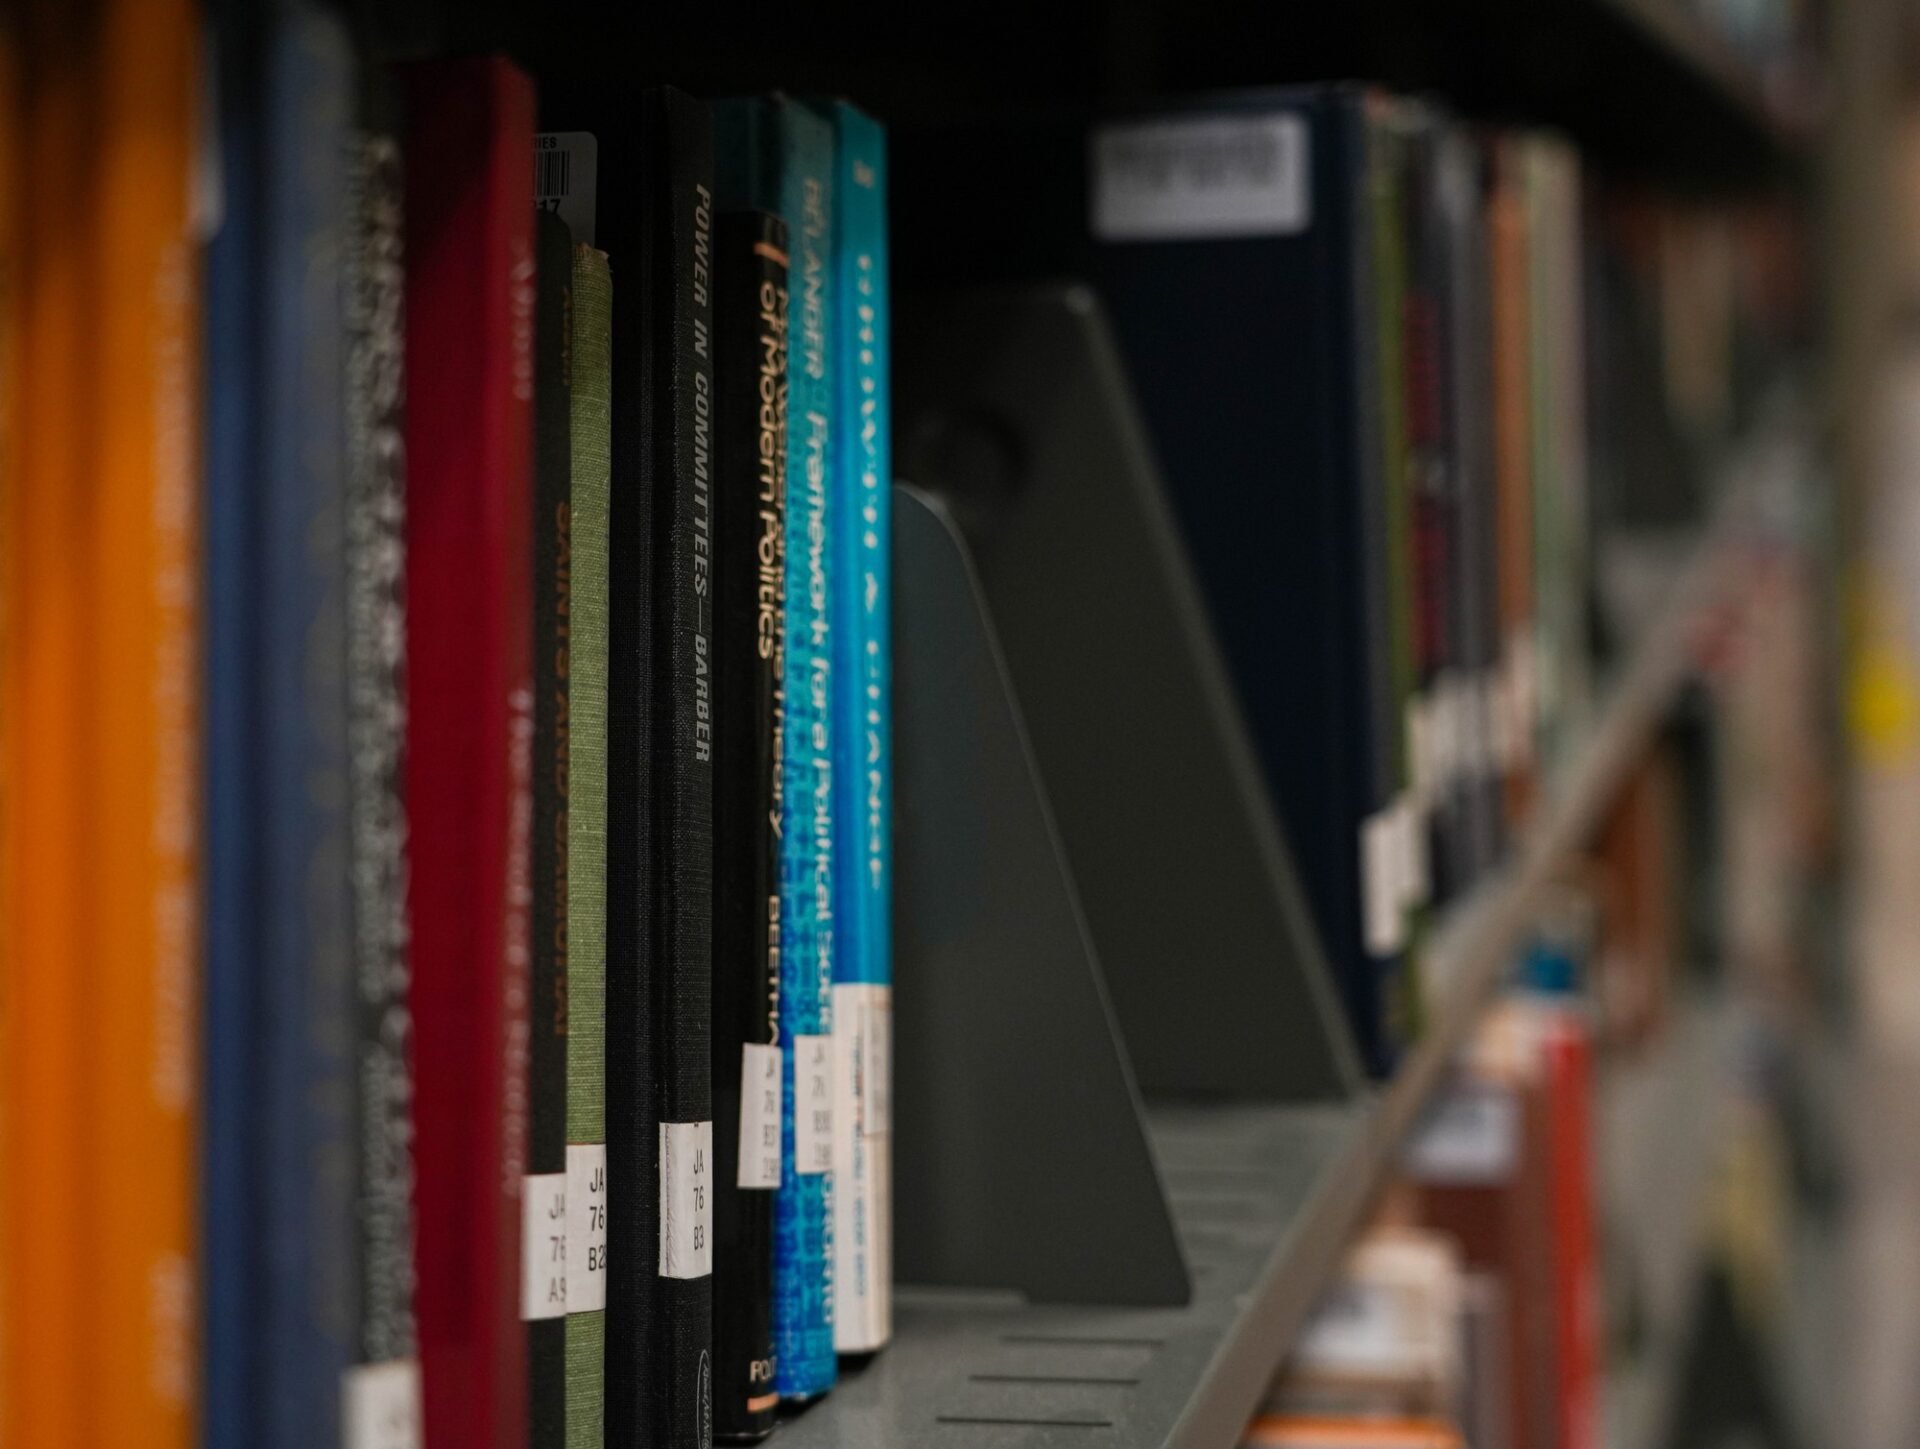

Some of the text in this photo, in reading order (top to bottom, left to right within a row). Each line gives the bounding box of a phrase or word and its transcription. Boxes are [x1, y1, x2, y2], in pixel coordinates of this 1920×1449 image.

[695, 184, 711, 307] POWER
[695, 319, 709, 359] IN
[758, 281, 780, 660] of Modern Politics
[806, 410, 832, 921] Framework for a Political
[768, 895, 781, 1045] BEETHA
[693, 1149, 704, 1174] JA
[590, 1168, 604, 1192] JA
[693, 1186, 704, 1212] 76
[589, 1204, 604, 1231] 76
[694, 1225, 704, 1250] B3
